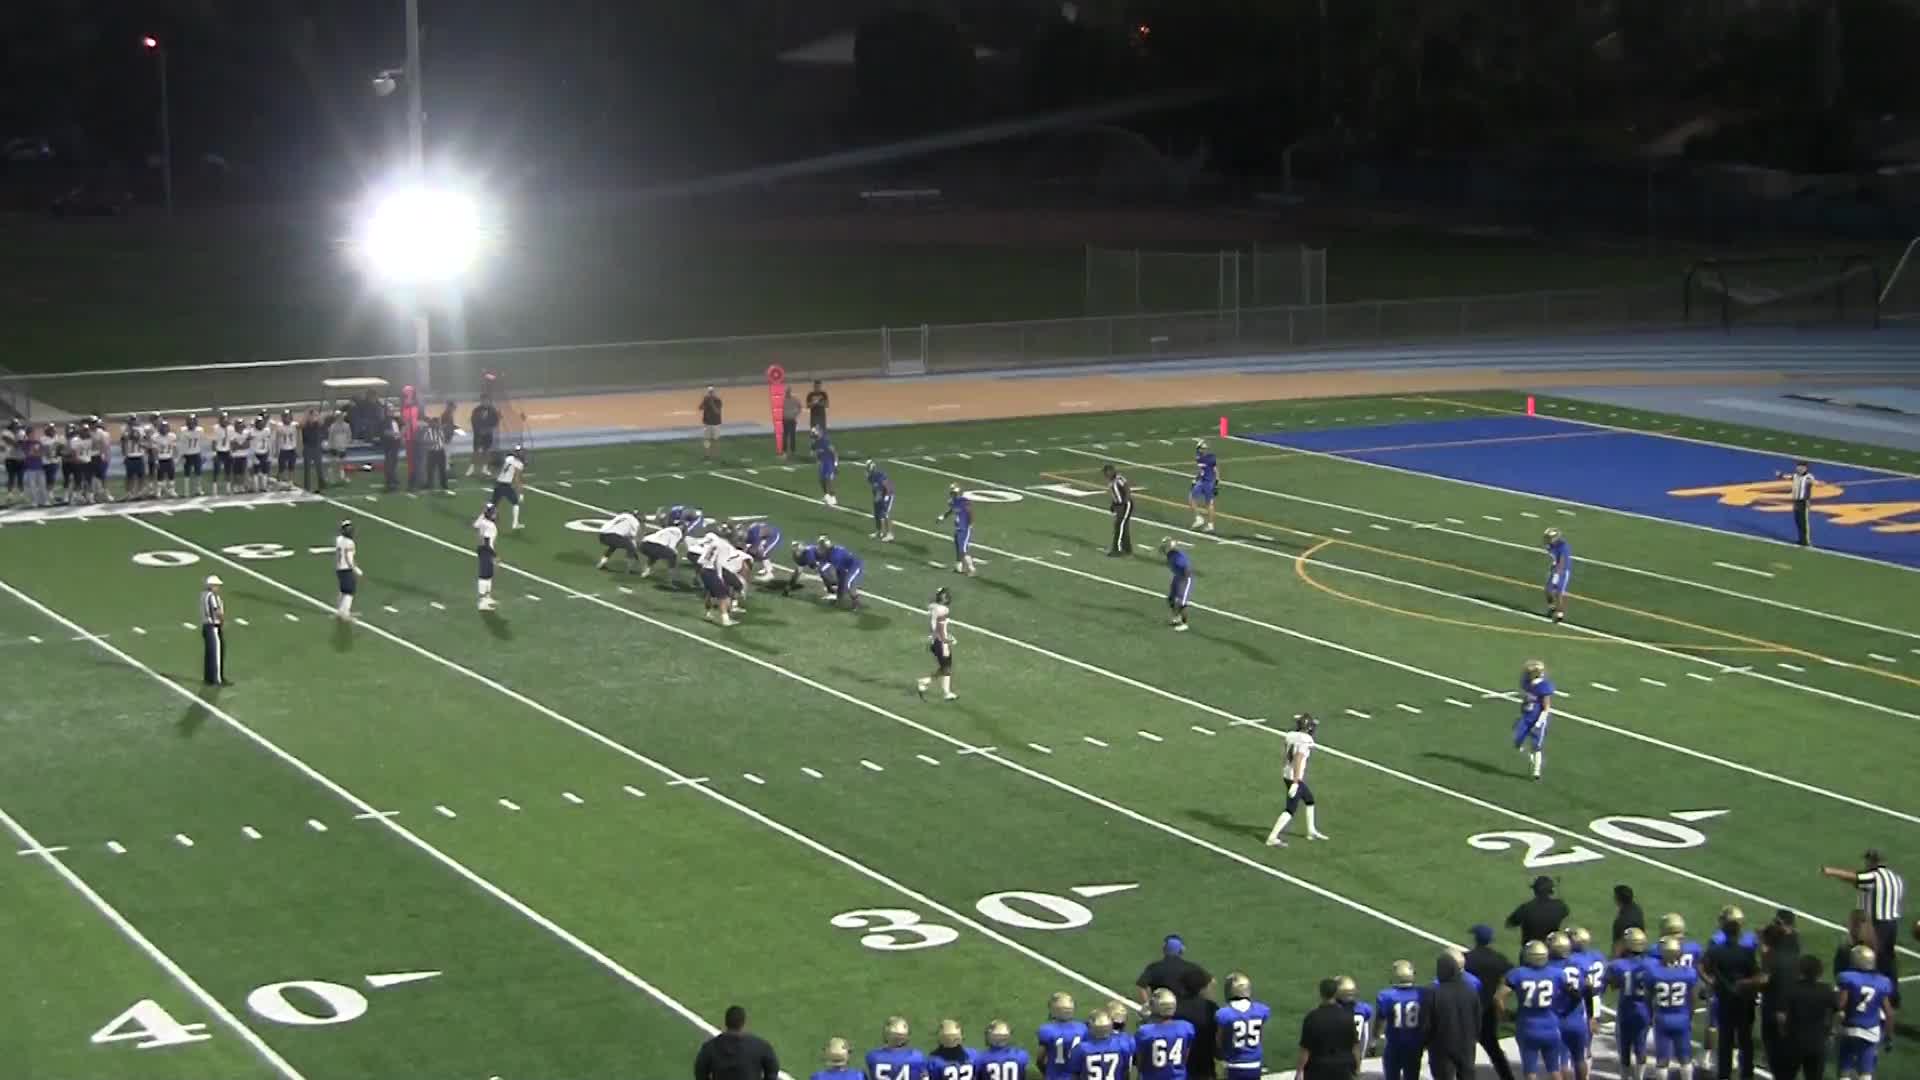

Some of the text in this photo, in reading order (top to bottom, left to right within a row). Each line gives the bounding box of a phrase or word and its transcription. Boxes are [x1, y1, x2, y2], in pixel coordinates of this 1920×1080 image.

[1467, 817, 1705, 868] 20
[830, 890, 1093, 950] 30
[1521, 979, 1553, 1007] 72
[1654, 981, 1687, 1007] 22
[1856, 986, 1876, 1012] 7
[91, 980, 368, 1049] 40
[1232, 1020, 1262, 1048] 25
[1086, 1053, 1119, 1080] 57
[1152, 1038, 1183, 1067] 64
[875, 1062, 911, 1080] 54
[987, 1061, 1019, 1080] 30
